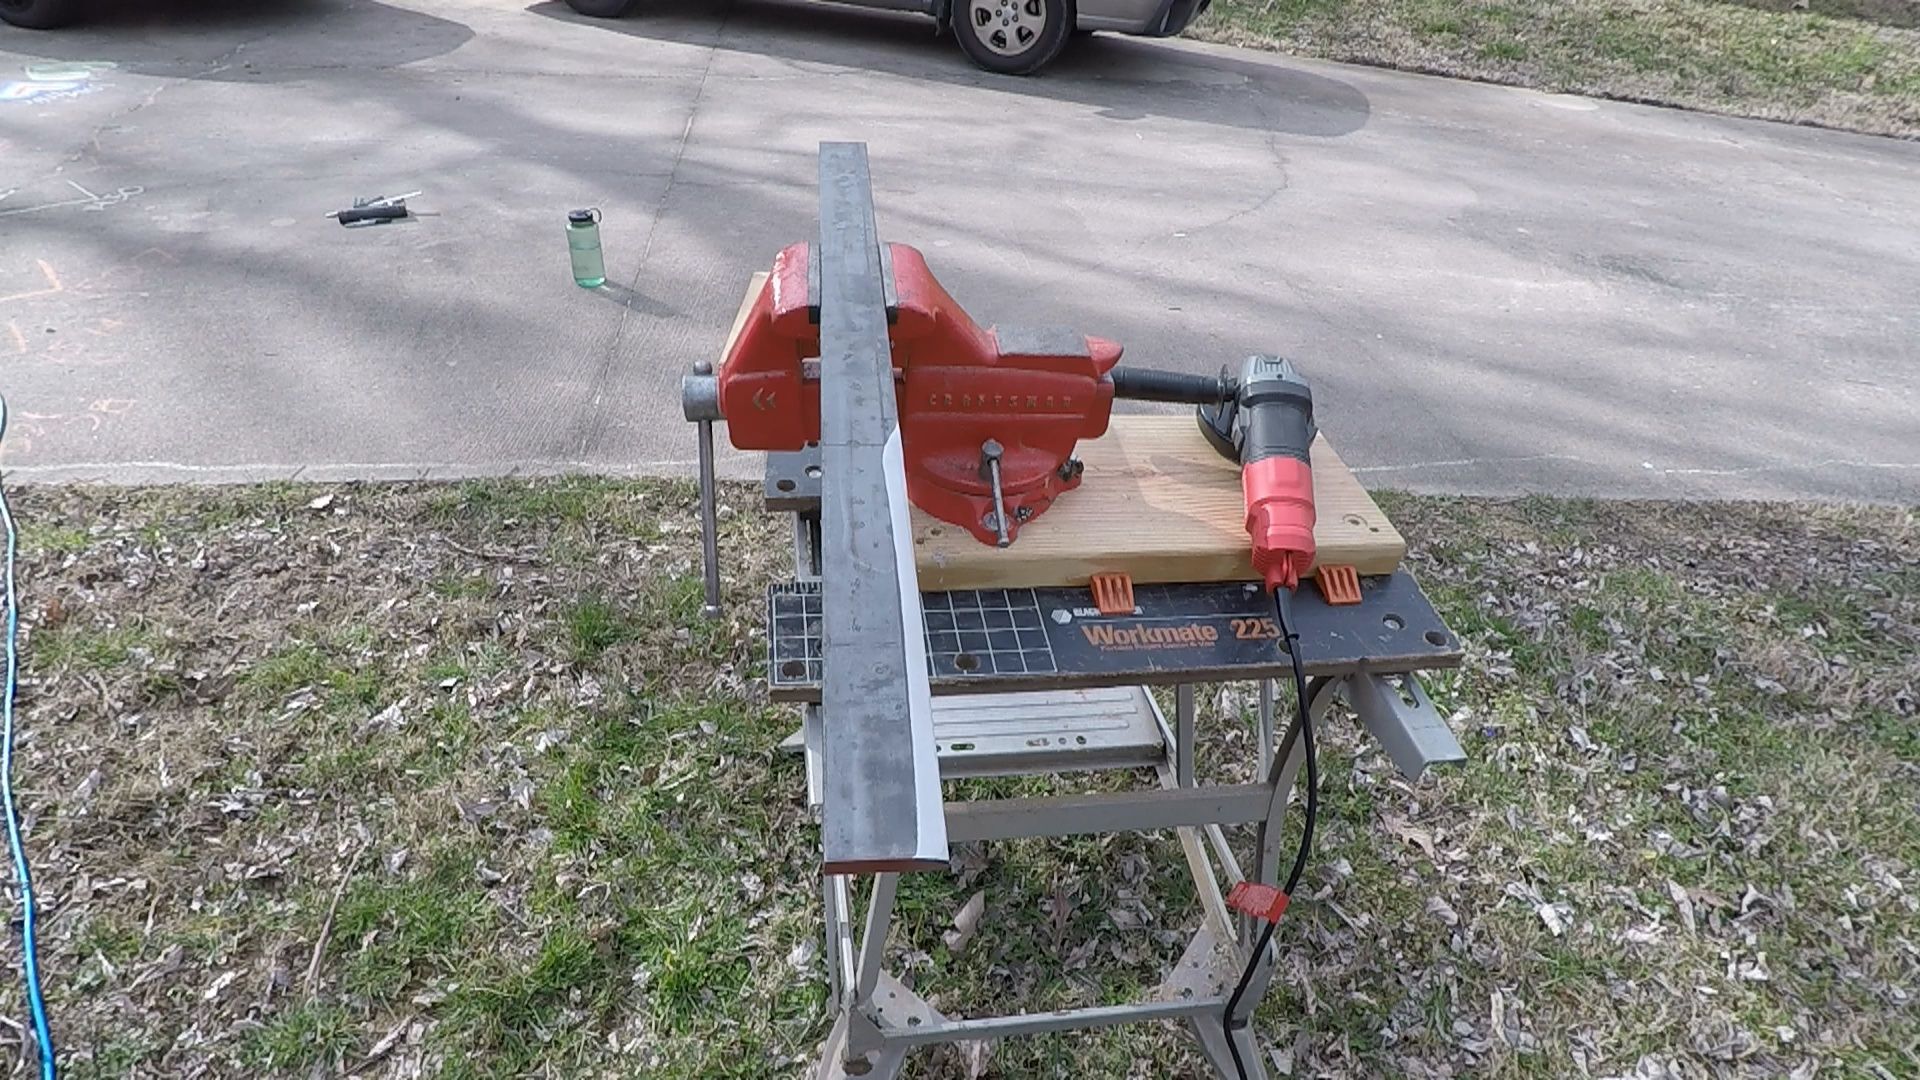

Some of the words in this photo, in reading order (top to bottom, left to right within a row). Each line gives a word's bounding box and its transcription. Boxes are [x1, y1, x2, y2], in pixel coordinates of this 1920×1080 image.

[928, 393, 1072, 409] CRAFTSMAN
[1081, 623, 1219, 646] Workmate
[1229, 617, 1281, 640] 225
